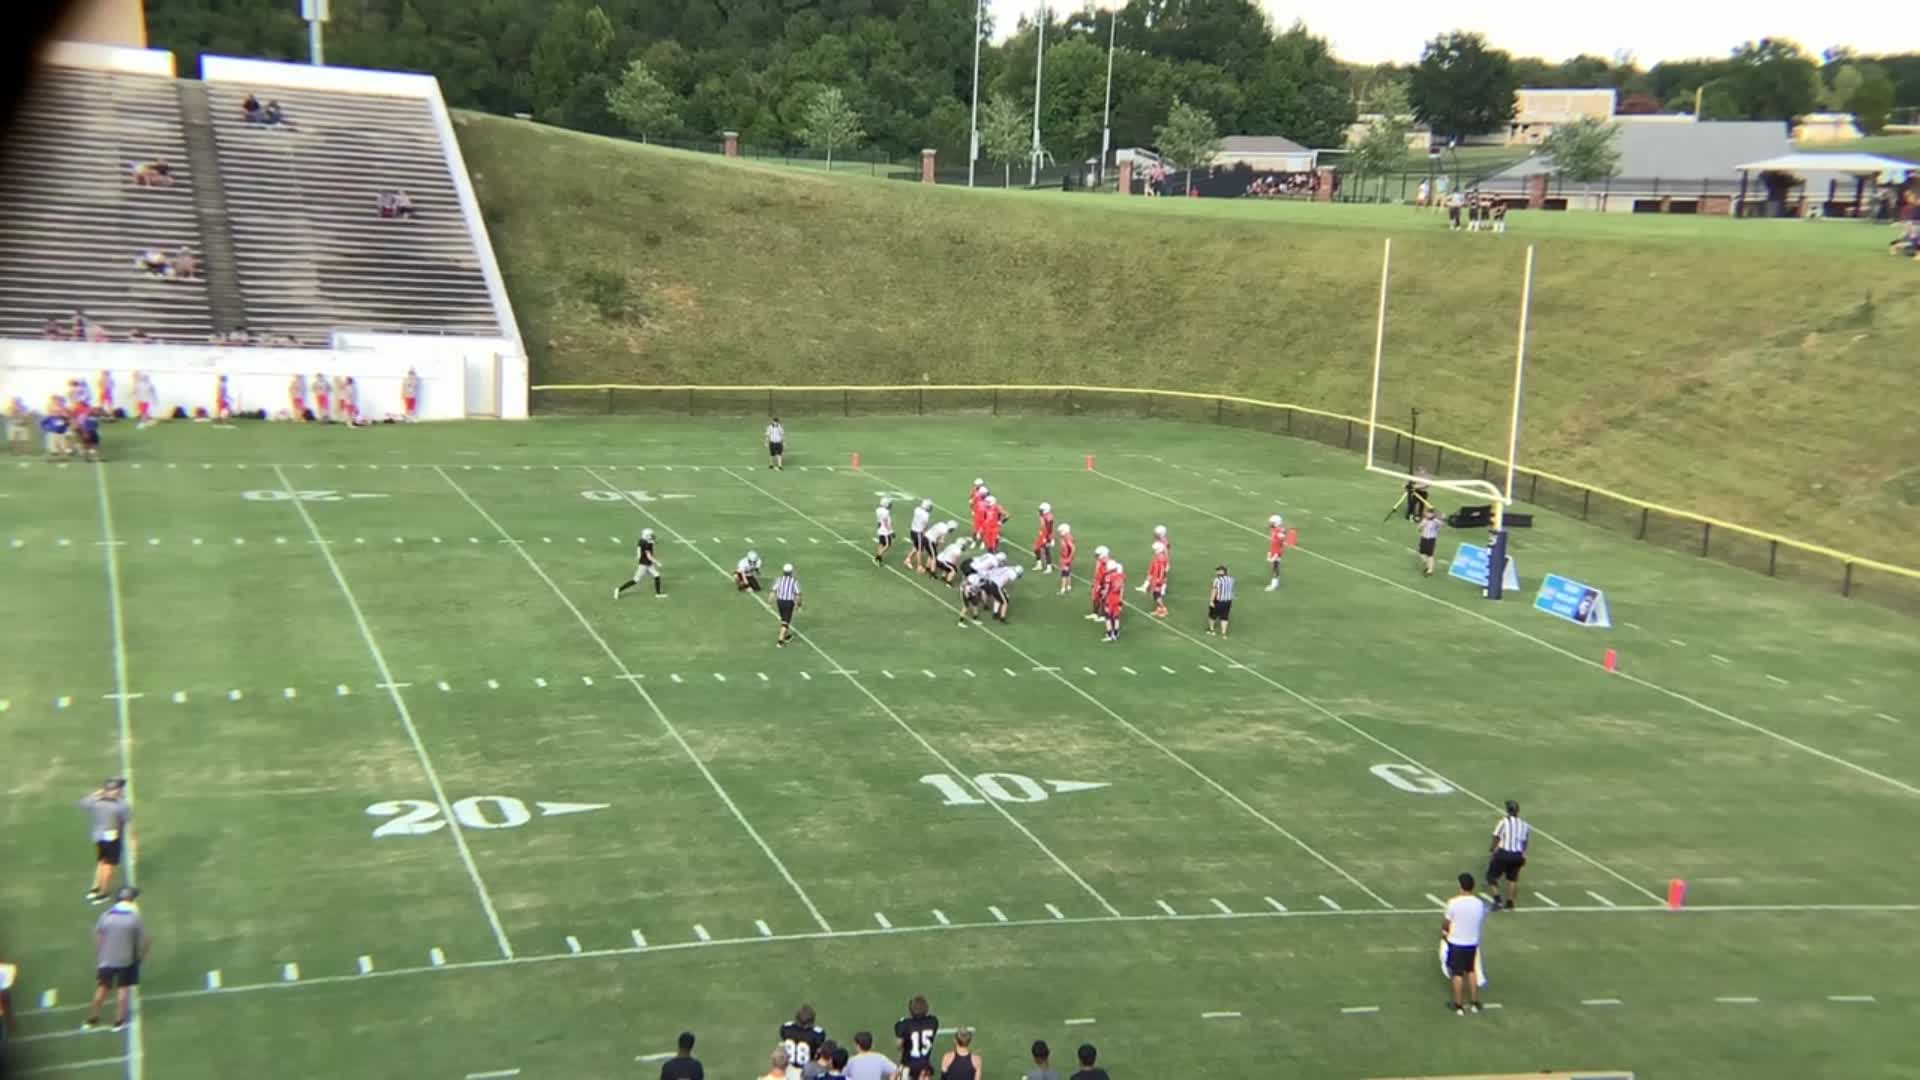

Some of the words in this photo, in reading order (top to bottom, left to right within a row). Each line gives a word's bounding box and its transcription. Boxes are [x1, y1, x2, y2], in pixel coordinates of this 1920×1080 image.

[919, 773, 1049, 806] 10
[1369, 764, 1456, 794] G
[364, 795, 532, 838] 20
[911, 1029, 933, 1058] 15
